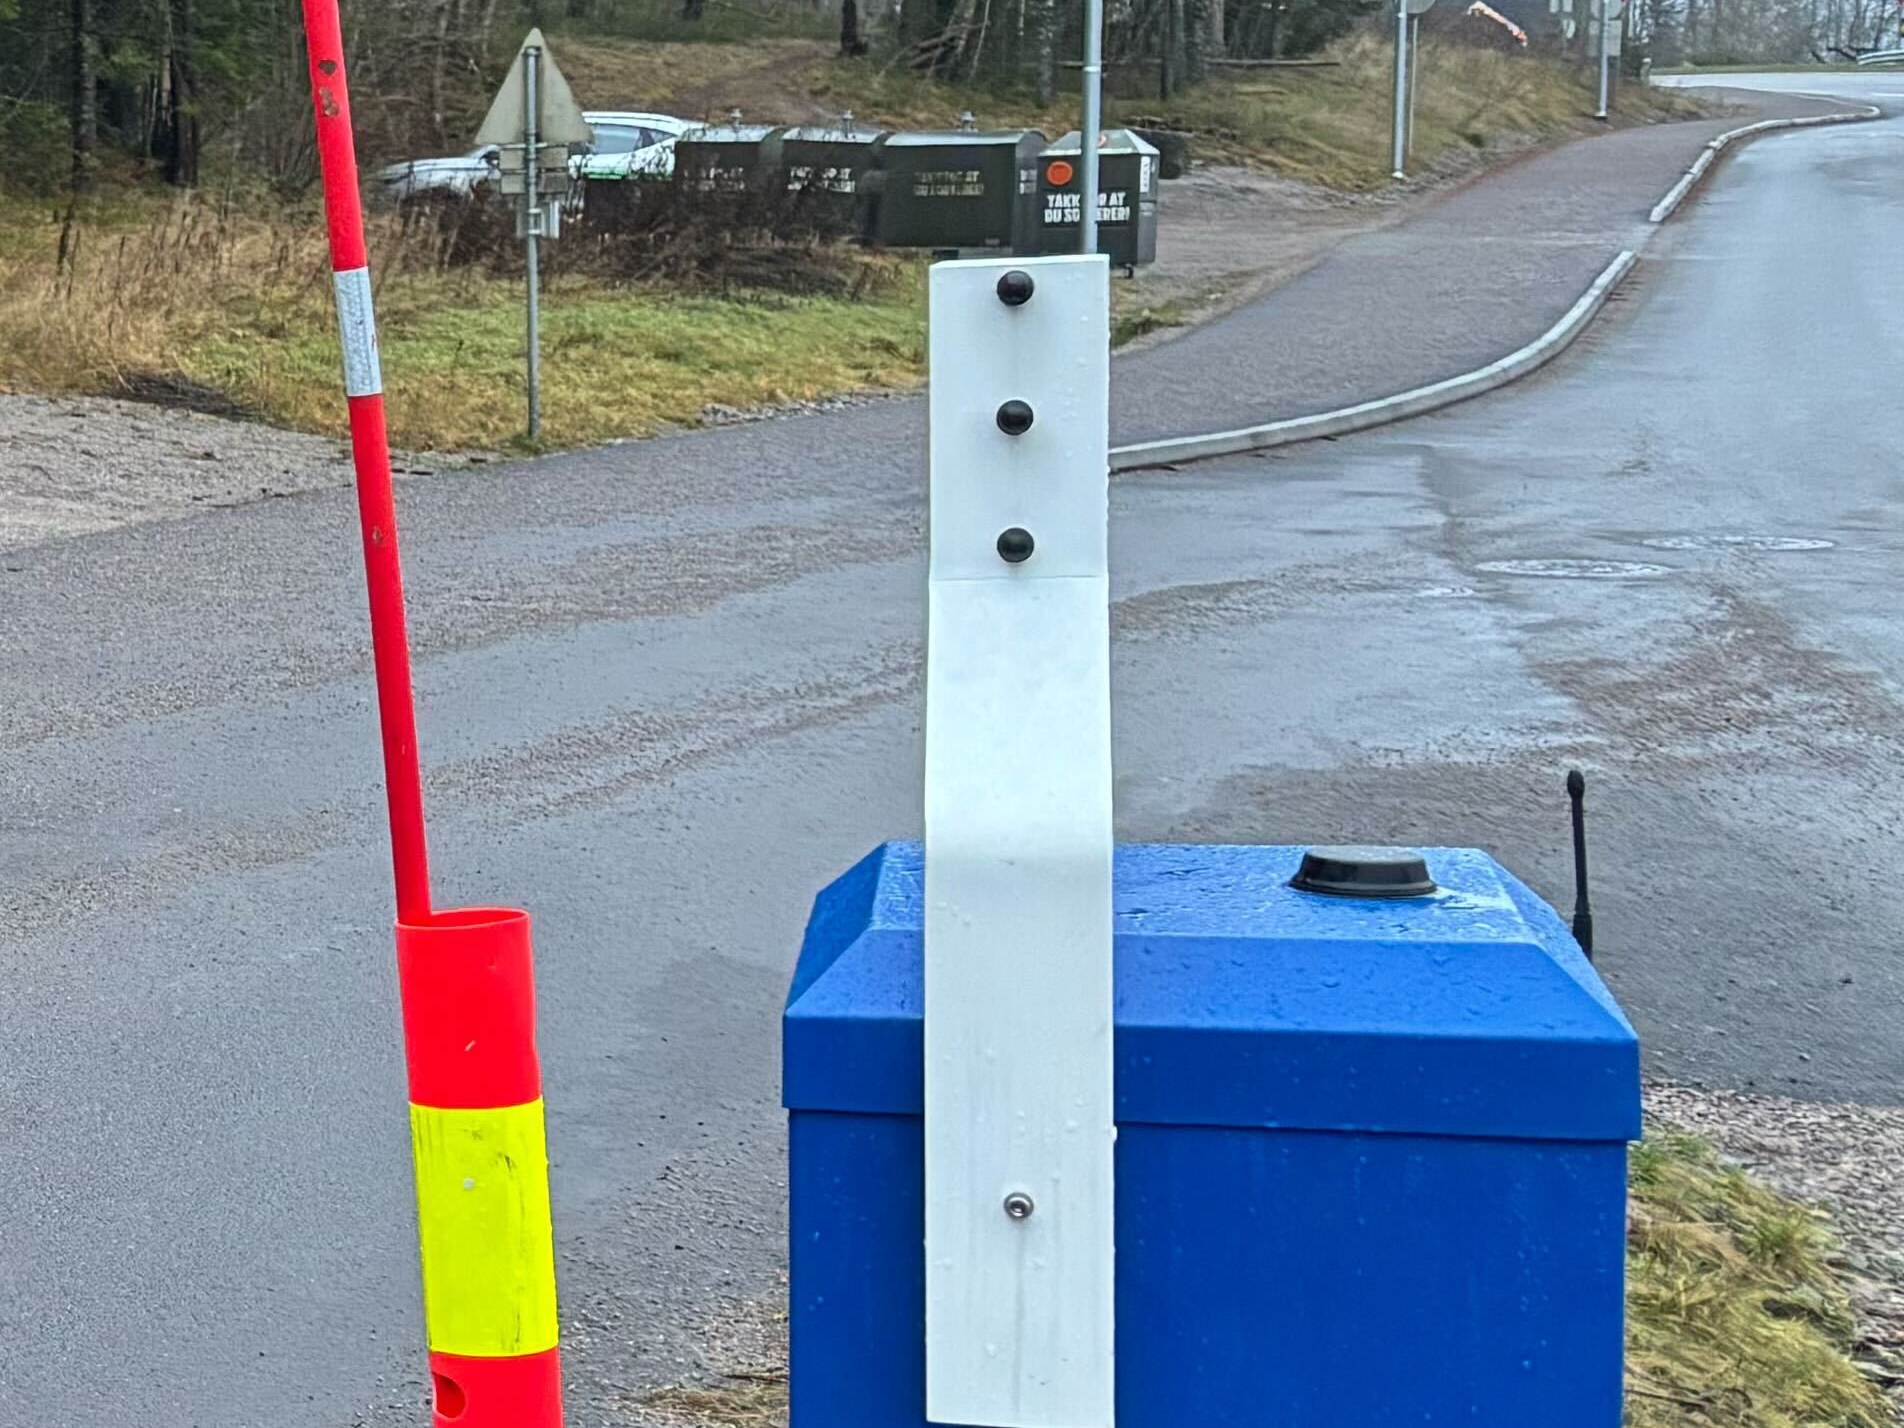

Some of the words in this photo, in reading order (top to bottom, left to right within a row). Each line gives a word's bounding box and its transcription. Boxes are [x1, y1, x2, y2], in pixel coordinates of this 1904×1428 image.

[1047, 193, 1081, 208] TAKK
[1109, 192, 1126, 206] AT
[1044, 208, 1062, 223] DU
[1063, 206, 1131, 223] SOERER!
